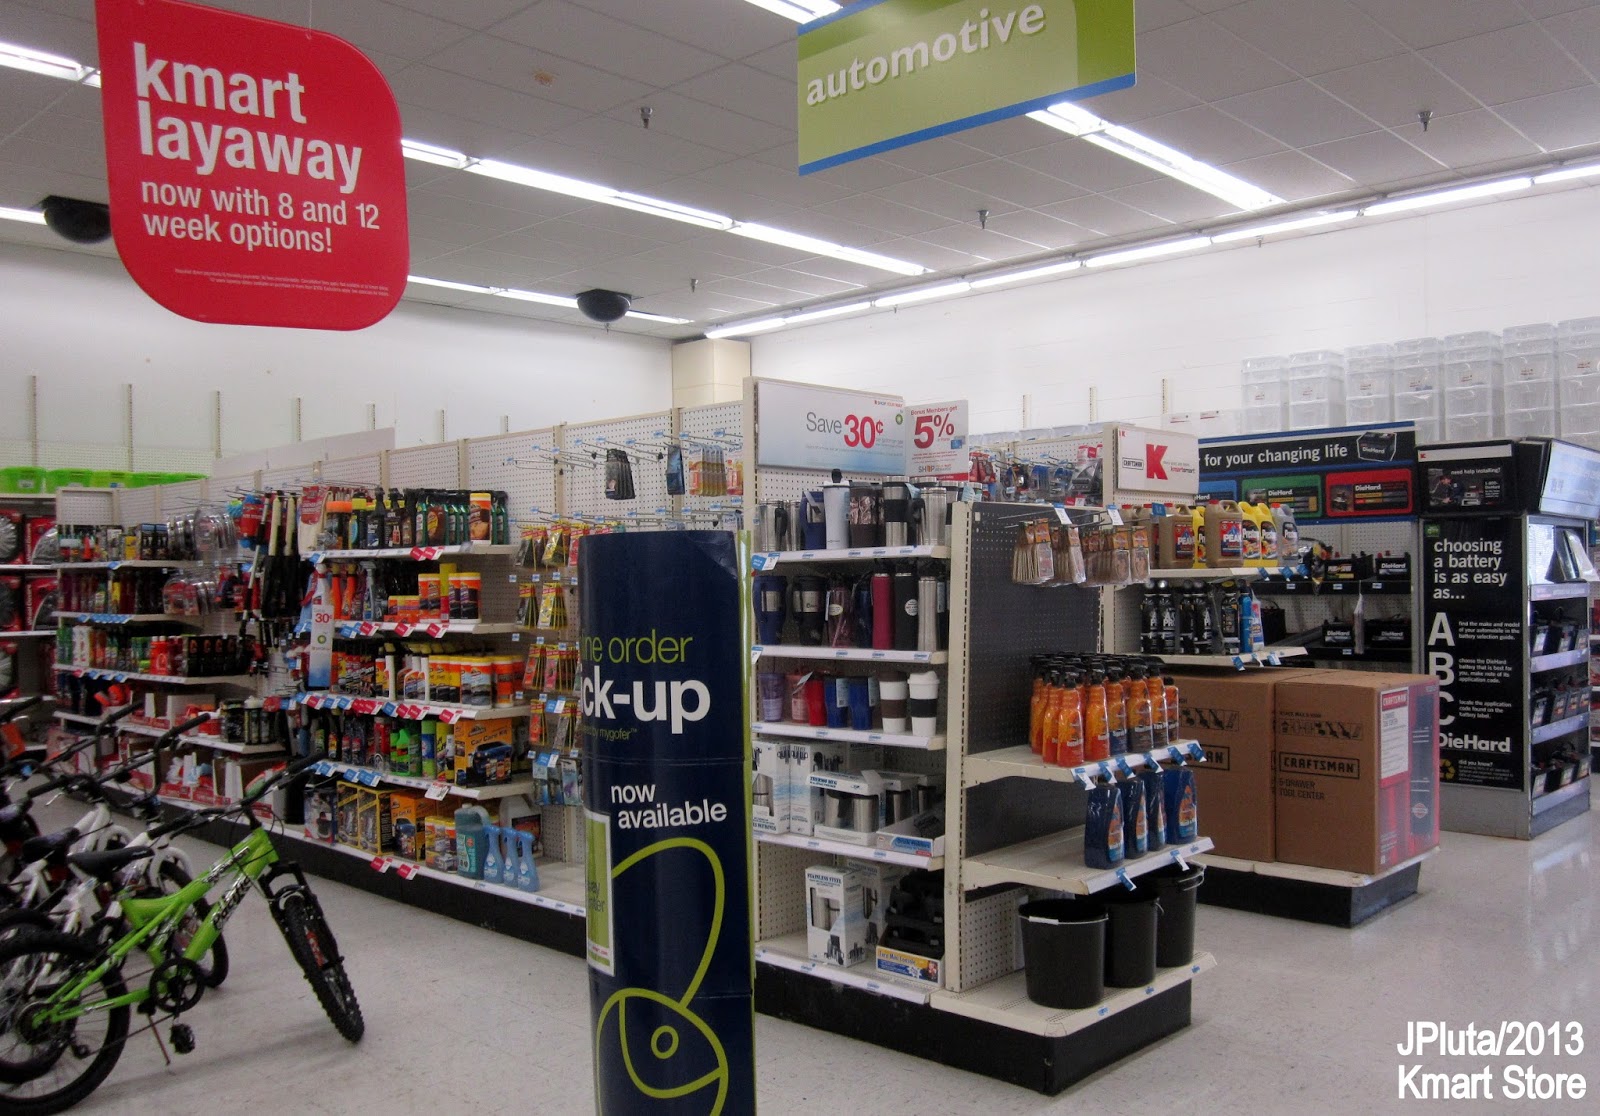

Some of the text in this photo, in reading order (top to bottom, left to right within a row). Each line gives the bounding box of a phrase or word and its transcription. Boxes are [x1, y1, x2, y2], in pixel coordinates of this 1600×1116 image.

[806, 5, 1045, 106] automotive
[133, 42, 307, 124] kmart
[137, 100, 362, 194] layaway
[142, 181, 380, 230] now with 8 and 12
[143, 212, 332, 253] week options!
[806, 411, 884, 449] Save 30¢
[913, 412, 954, 449] 5%
[1123, 460, 1142, 468] CRAFTSMAN
[1146, 443, 1168, 480] K
[1204, 453, 1222, 467] for
[1226, 452, 1253, 468] your
[1258, 446, 1320, 464] changing
[1325, 444, 1348, 458] life
[1355, 484, 1381, 492] DieHard
[1434, 538, 1502, 554] choosing
[1434, 554, 1502, 571] a battery
[1433, 588, 1465, 599] as...
[1434, 571, 1507, 587] is as easy
[1427, 612, 1455, 647] A
[608, 629, 693, 663] order
[1429, 652, 1455, 686] B
[1284, 757, 1354, 773] CRAFTSMAN
[611, 784, 655, 803] now
[1280, 788, 1325, 800] TOOL CENTER
[618, 798, 727, 829] available
[807, 873, 829, 881] STAINLESS
